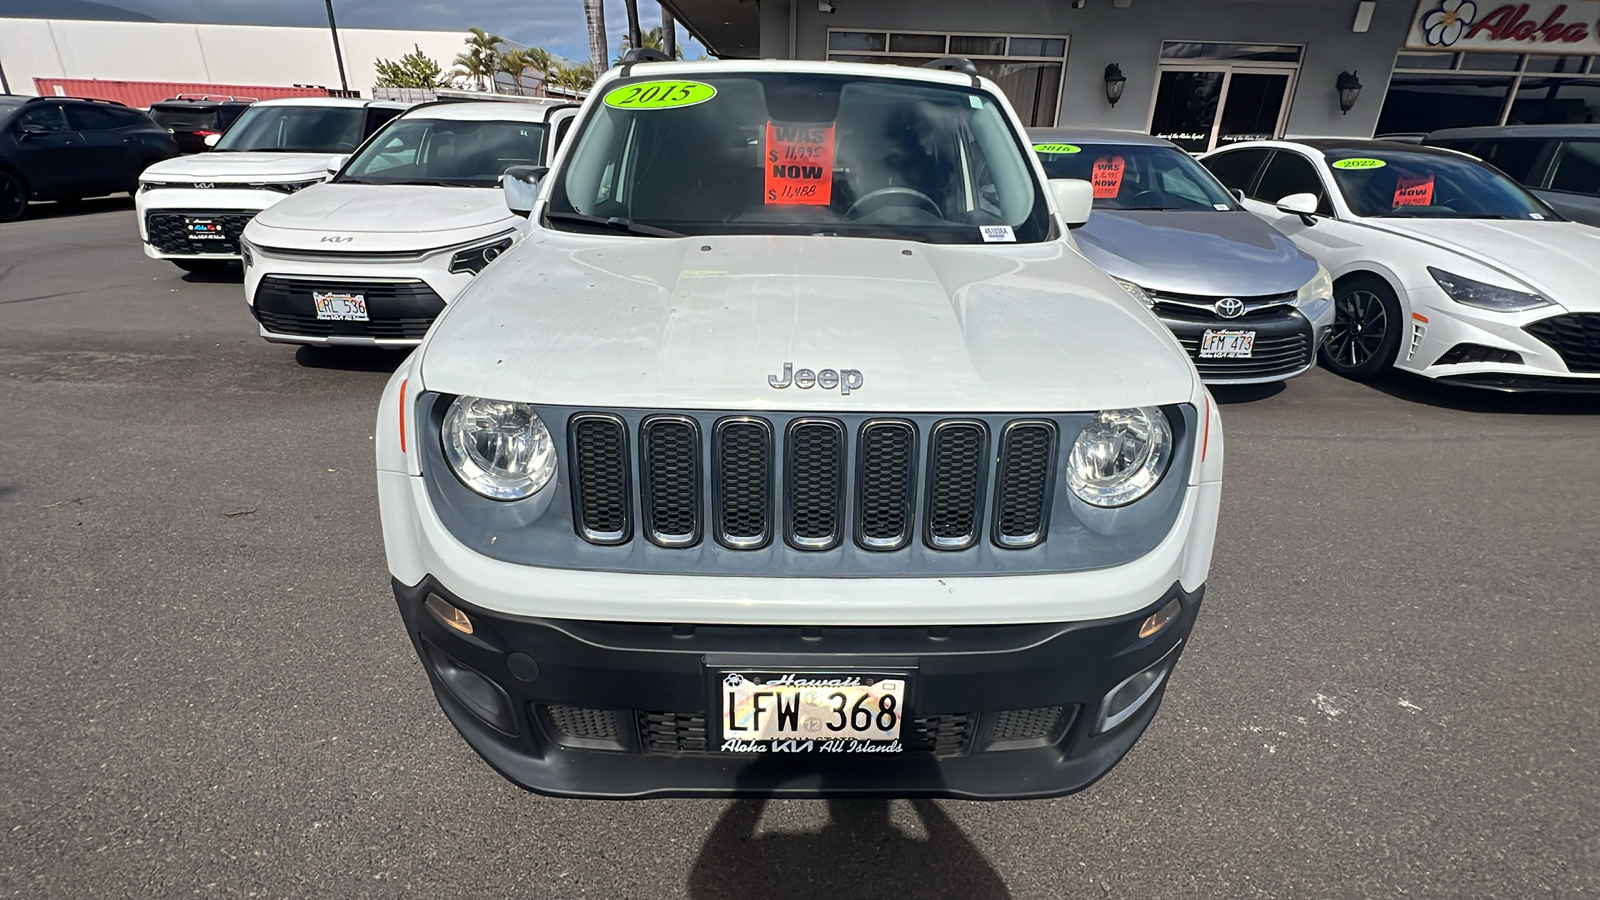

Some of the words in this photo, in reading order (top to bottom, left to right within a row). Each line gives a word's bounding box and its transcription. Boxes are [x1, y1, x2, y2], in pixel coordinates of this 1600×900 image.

[1464, 3, 1590, 43] Aloha
[618, 84, 698, 105] 2015
[775, 127, 824, 144] WAS
[769, 149, 778, 163] $
[785, 146, 823, 161] 11,995
[773, 165, 823, 179] NOW
[1343, 160, 1377, 168] 2022
[768, 188, 777, 201] $
[782, 185, 816, 199] 11,488
[1399, 189, 1428, 197] NOW
[316, 299, 338, 314] LRL
[343, 299, 365, 314] 536
[1203, 336, 1226, 351] LFM
[1231, 336, 1252, 351] 473
[768, 362, 864, 396] Jeep
[766, 673, 861, 687] Hawaii
[729, 691, 801, 732] LFW
[826, 692, 897, 732] 368
[720, 737, 768, 753] Aloha
[819, 739, 843, 753] All
[846, 739, 904, 754] Islands
